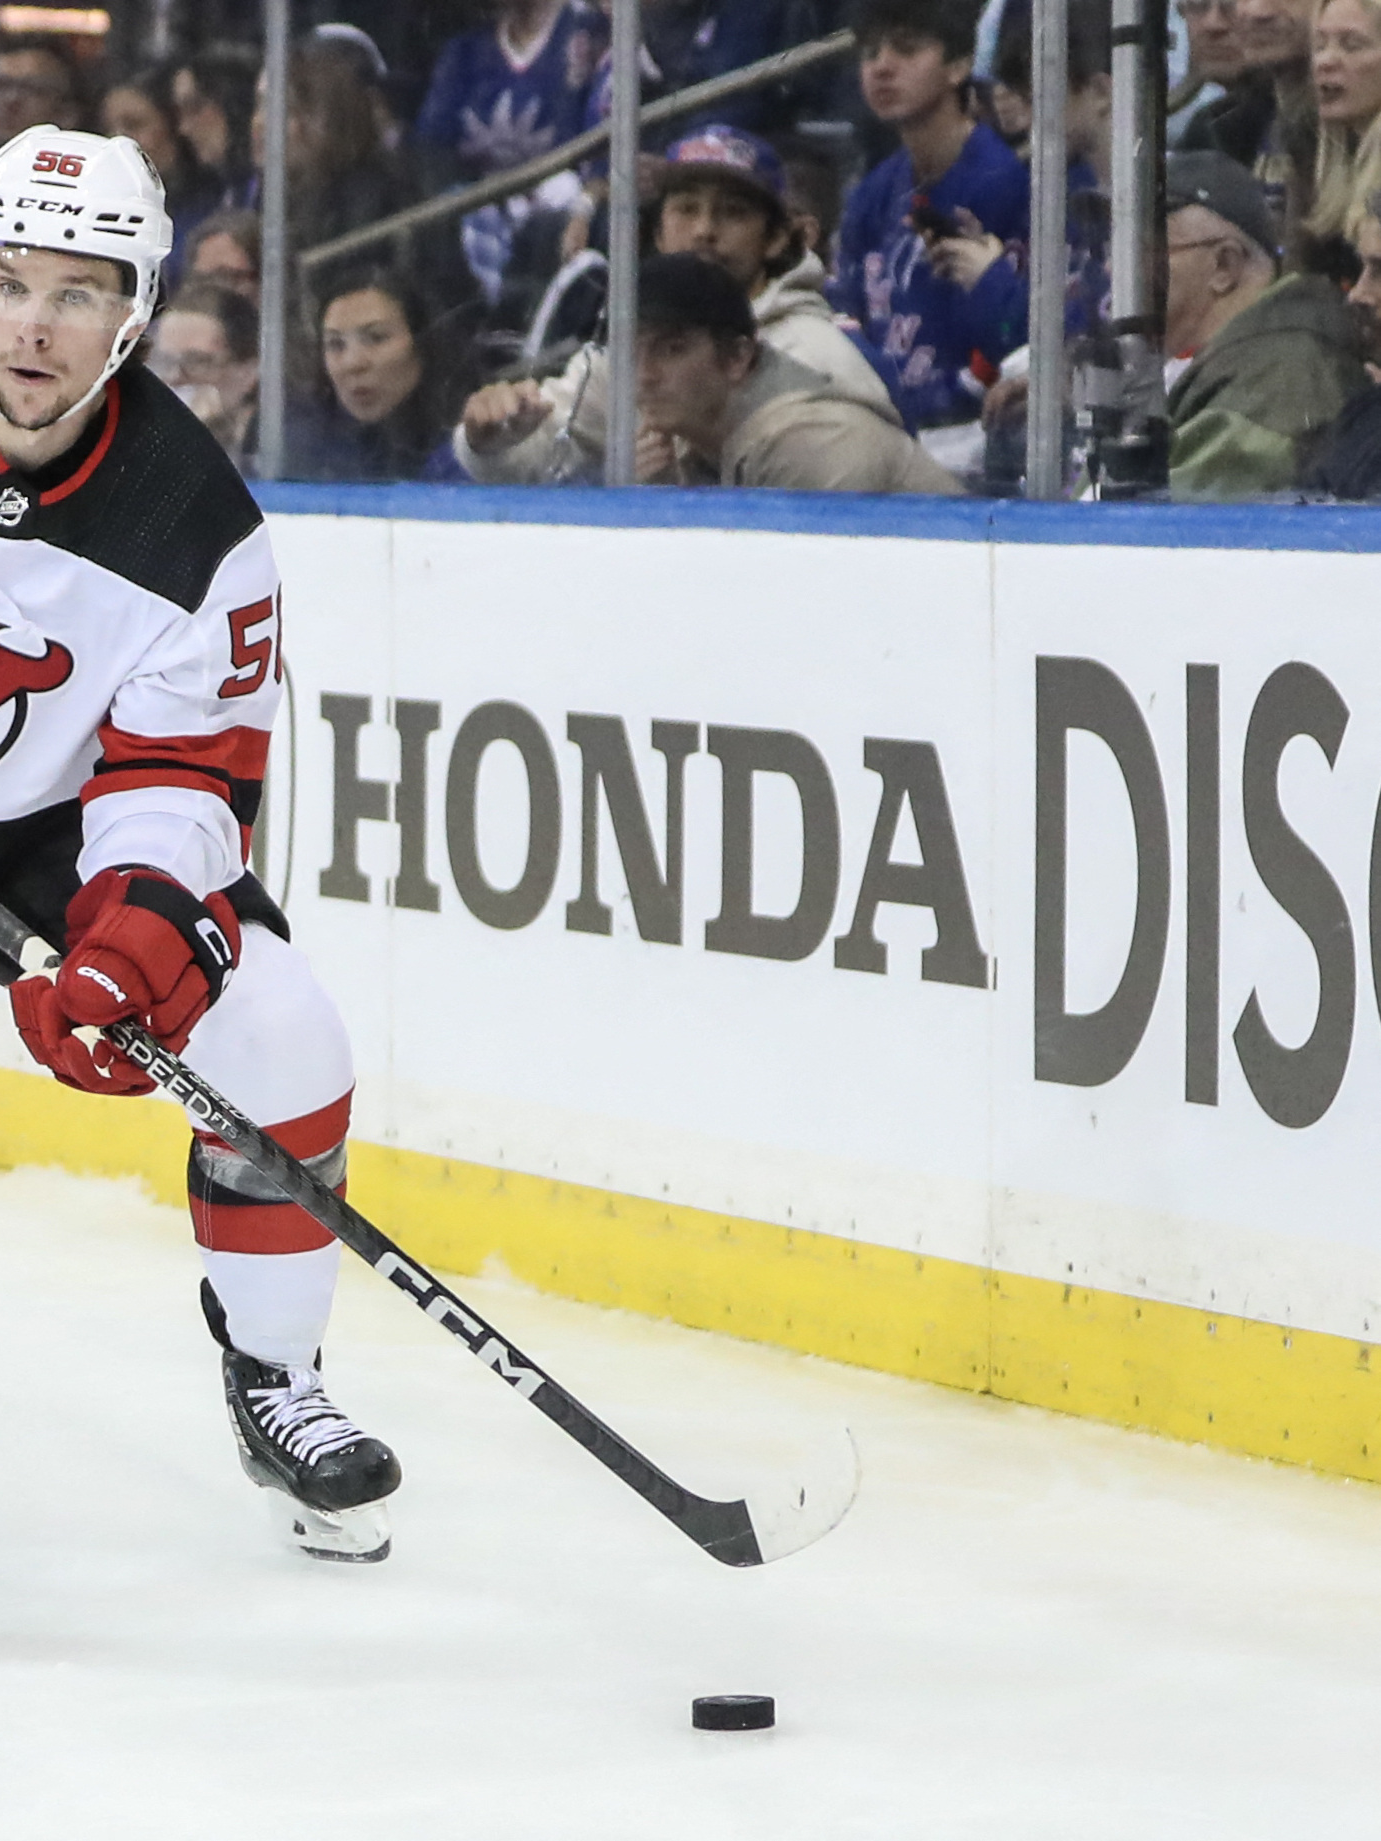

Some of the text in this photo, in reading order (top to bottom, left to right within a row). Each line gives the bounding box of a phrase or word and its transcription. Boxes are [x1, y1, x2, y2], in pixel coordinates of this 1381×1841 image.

[16, 197, 85, 216] CCM
[33, 151, 86, 177] 56
[217, 580, 282, 699] 5
[319, 690, 998, 991] HONDA
[1034, 653, 1381, 1128] DIS
[77, 966, 127, 1003] CCM
[374, 1251, 548, 1401] CCM
